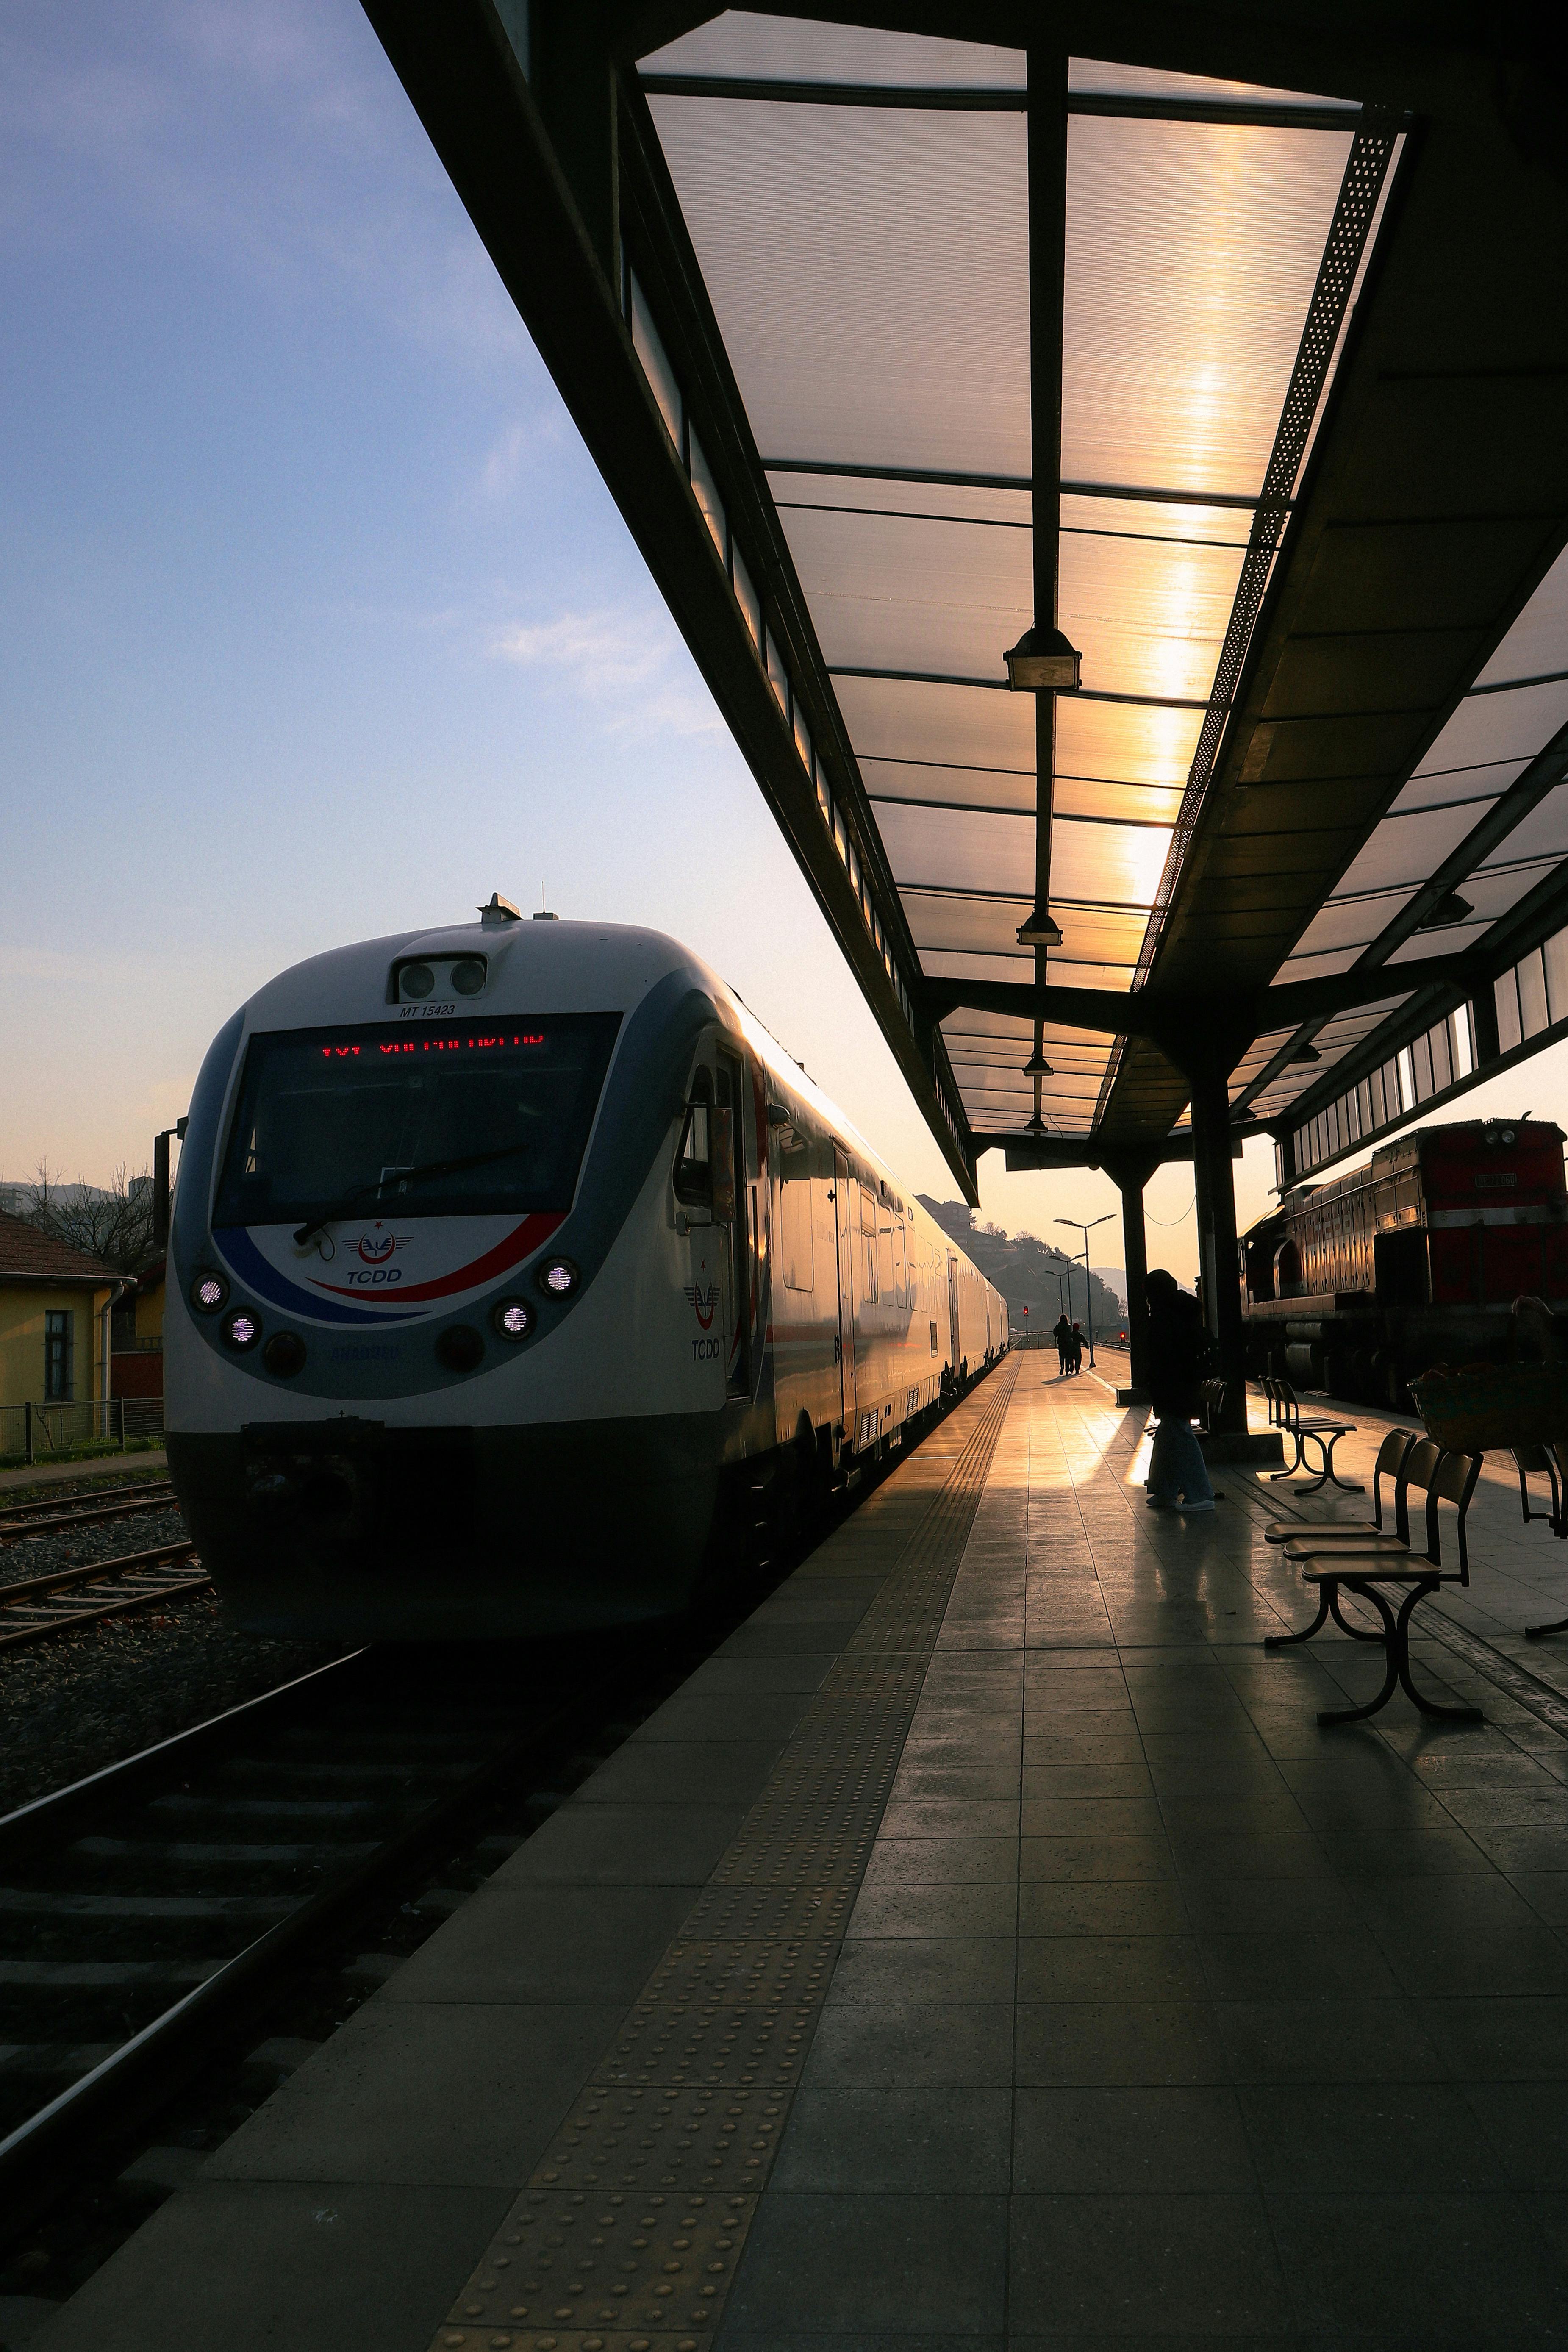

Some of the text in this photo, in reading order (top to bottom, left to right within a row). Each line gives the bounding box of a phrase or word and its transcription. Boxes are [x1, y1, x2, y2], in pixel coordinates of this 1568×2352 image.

[400, 1005, 455, 1017] MT 15423
[1501, 1175, 1515, 1184] 060
[347, 1269, 402, 1284] TCDD
[691, 1338, 719, 1361] TCDD
